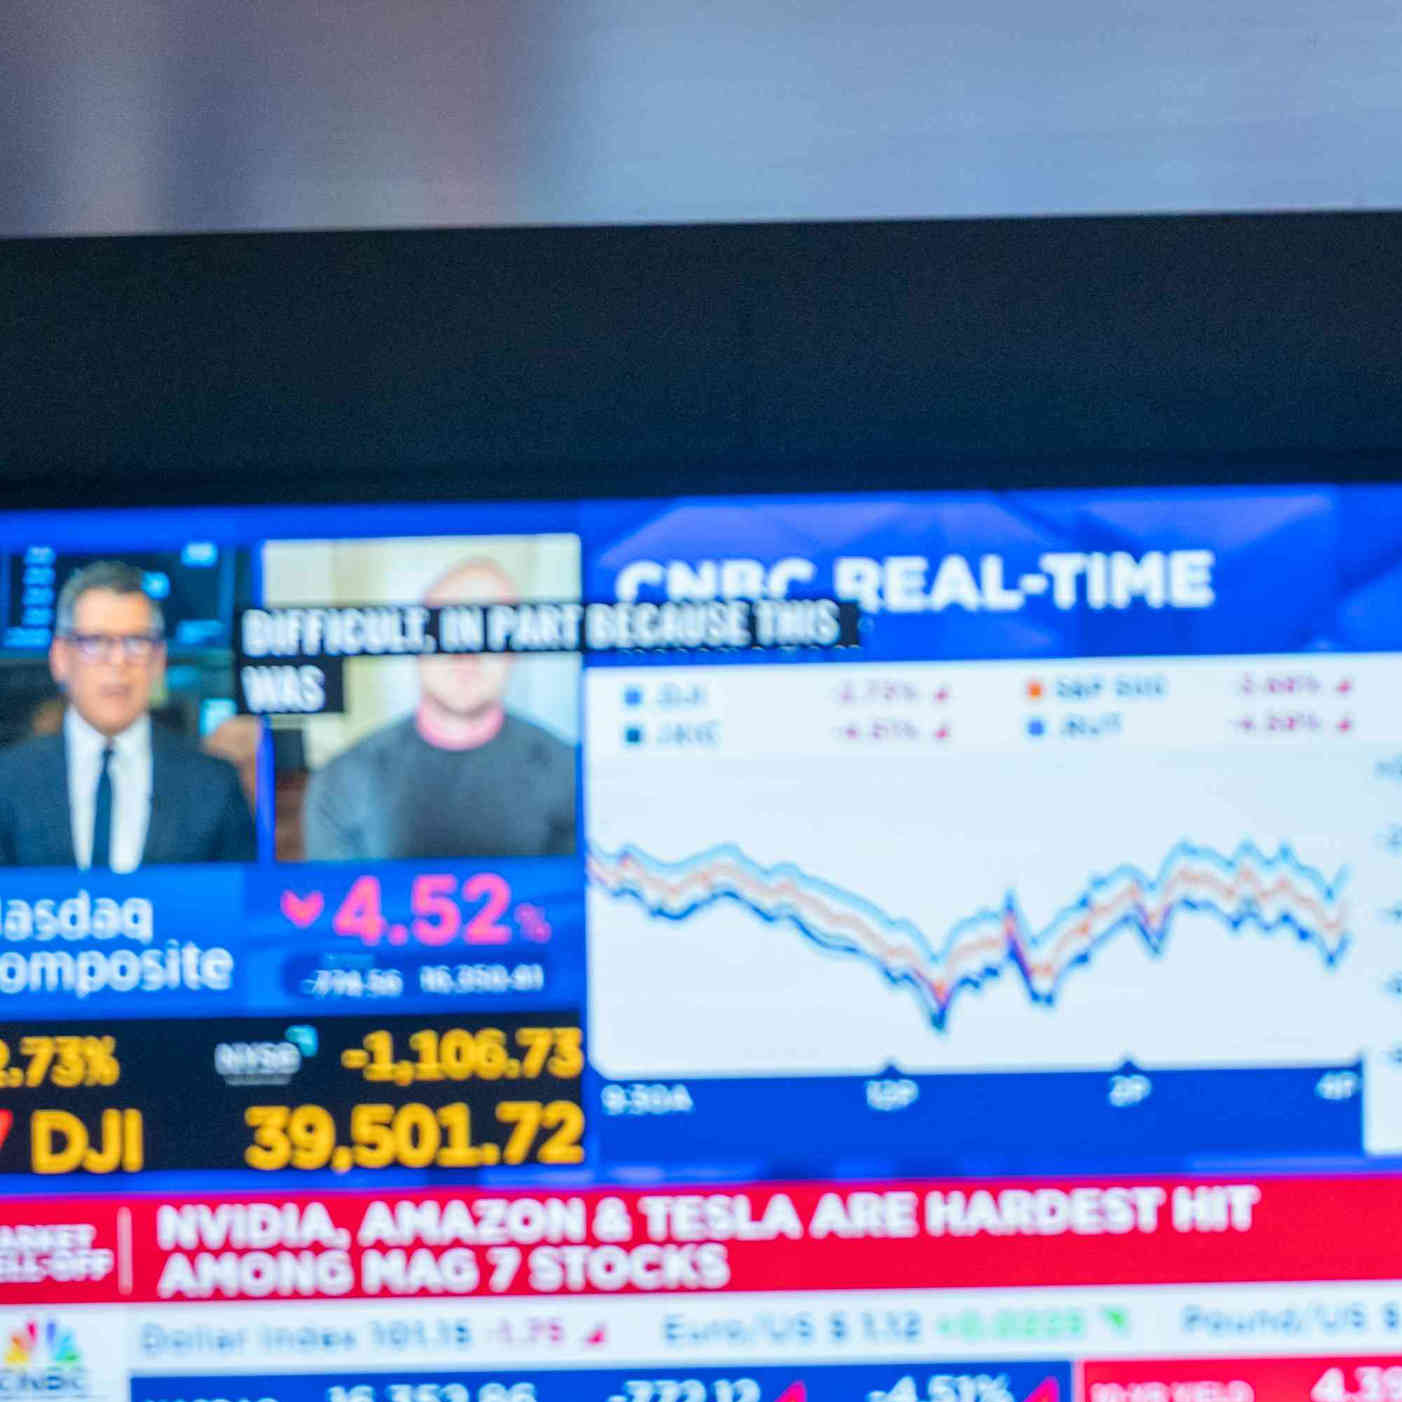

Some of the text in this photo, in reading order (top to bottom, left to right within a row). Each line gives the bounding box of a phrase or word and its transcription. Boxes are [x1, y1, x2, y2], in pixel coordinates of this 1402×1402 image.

[833, 551, 1216, 613] REAL-TIME
[439, 606, 485, 652] IN
[487, 604, 583, 652] PART
[585, 601, 750, 650] BECAUSE
[755, 598, 841, 647] THIS
[241, 664, 326, 713] WAS
[0, 888, 154, 944] asdaq
[340, 1026, 584, 1087] -1,106.73
[31, 1100, 585, 1174] DJI 39,501.72
[156, 1184, 1262, 1250] NVIDIA, AMAZON & TESLA ARE HARDEST HIT
[156, 1243, 731, 1299] AMONG MAG 7 STOCKS
